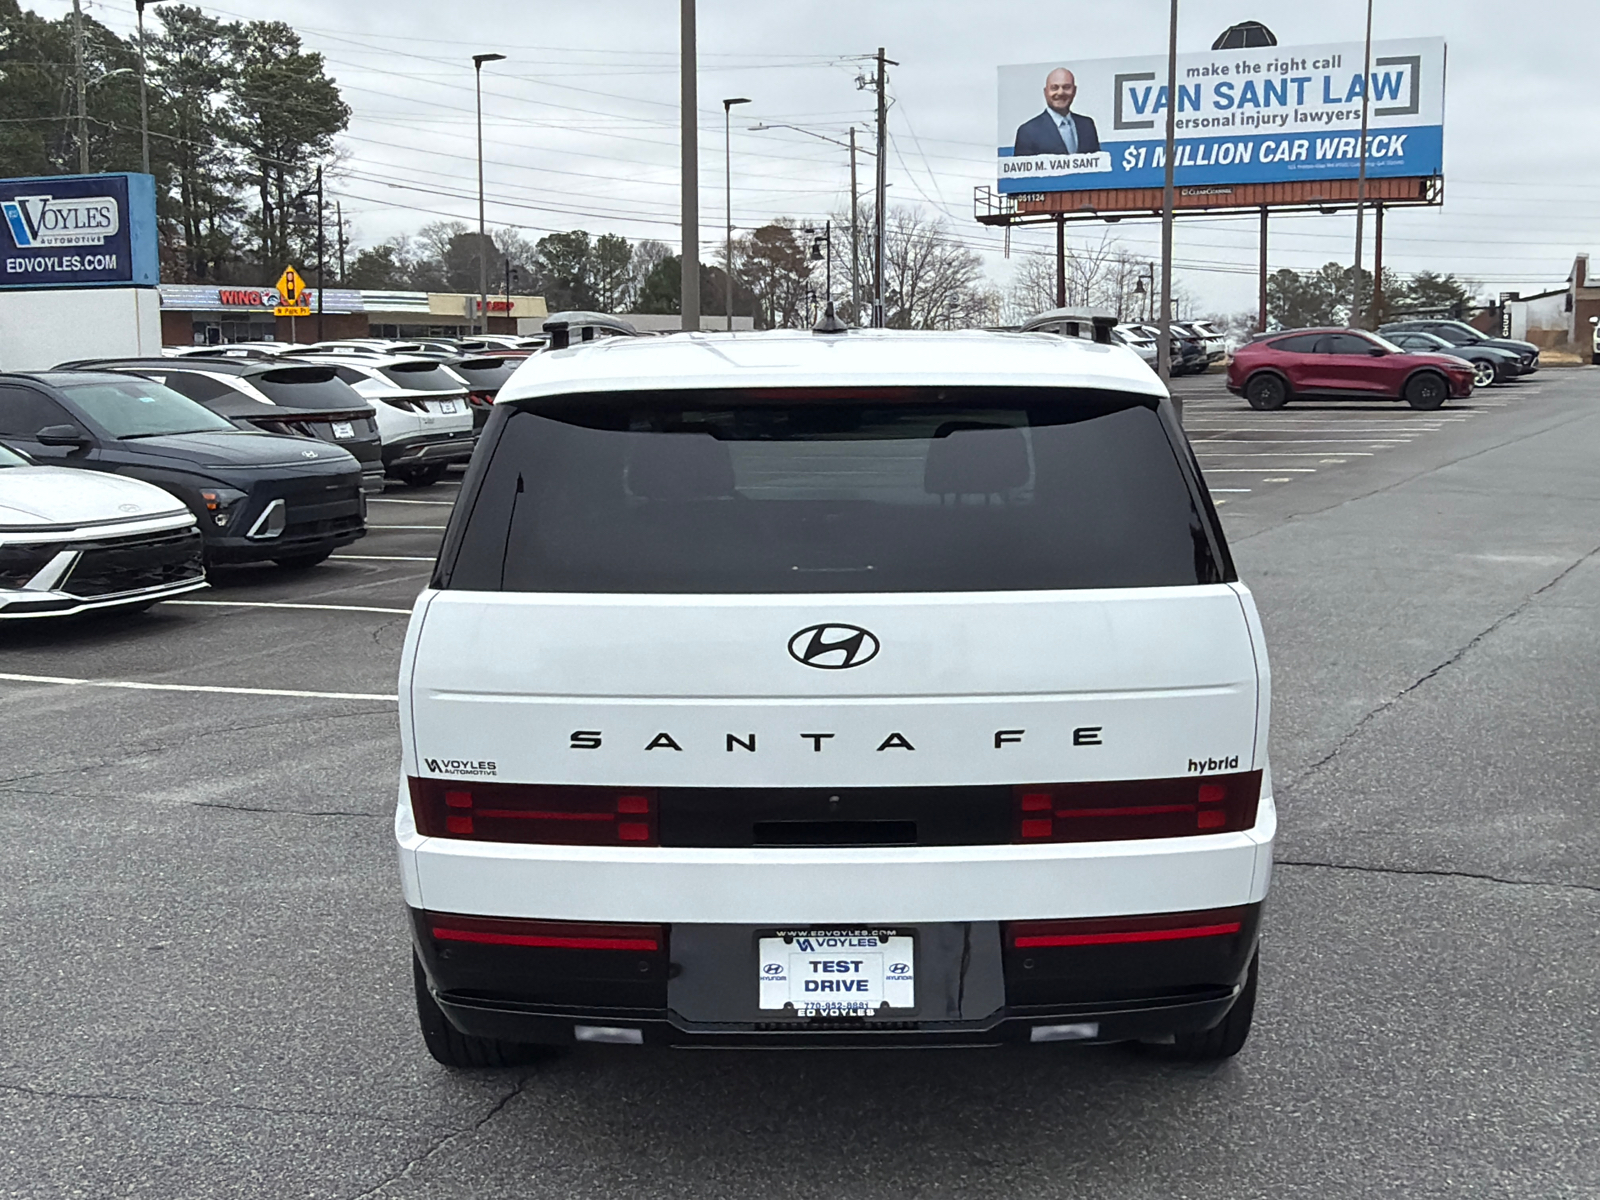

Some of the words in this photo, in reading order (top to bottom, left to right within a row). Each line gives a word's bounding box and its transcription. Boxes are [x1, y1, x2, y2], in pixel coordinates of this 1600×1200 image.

[1186, 62, 1230, 78] make
[1234, 60, 1262, 75] the
[1266, 57, 1307, 76] right
[1312, 54, 1342, 70] call
[1128, 83, 1202, 115] VAN
[1212, 76, 1313, 111] SANT
[1322, 71, 1404, 104] LAW
[1172, 112, 1236, 130] ersonal
[1240, 110, 1290, 129] injury
[1293, 108, 1362, 126] lawyers
[1121, 144, 1148, 172] $1
[1151, 141, 1254, 169] MILLION
[1258, 139, 1310, 164] CAR
[1314, 134, 1409, 161] WRECK
[1003, 161, 1033, 174] DAVID
[1035, 160, 1048, 172] M.
[1049, 158, 1071, 171] VAN
[1072, 157, 1101, 170] SANT
[17, 198, 112, 241] VOYLES
[40, 236, 102, 245] AUTOMOTIVE
[6, 254, 117, 273] EDVOYLES.COM
[219, 289, 260, 306] WING
[570, 730, 915, 753] SANTA
[994, 726, 1103, 750] FE
[441, 759, 497, 770] VOYLES
[444, 768, 497, 776] AUTOMOTIVE
[1187, 755, 1239, 776] hybrid
[815, 938, 878, 948] VOYLES
[809, 960, 864, 974] TEST
[804, 979, 869, 993] DRIVE
[797, 1008, 816, 1017] ED
[819, 1008, 875, 1017] VOYLES
